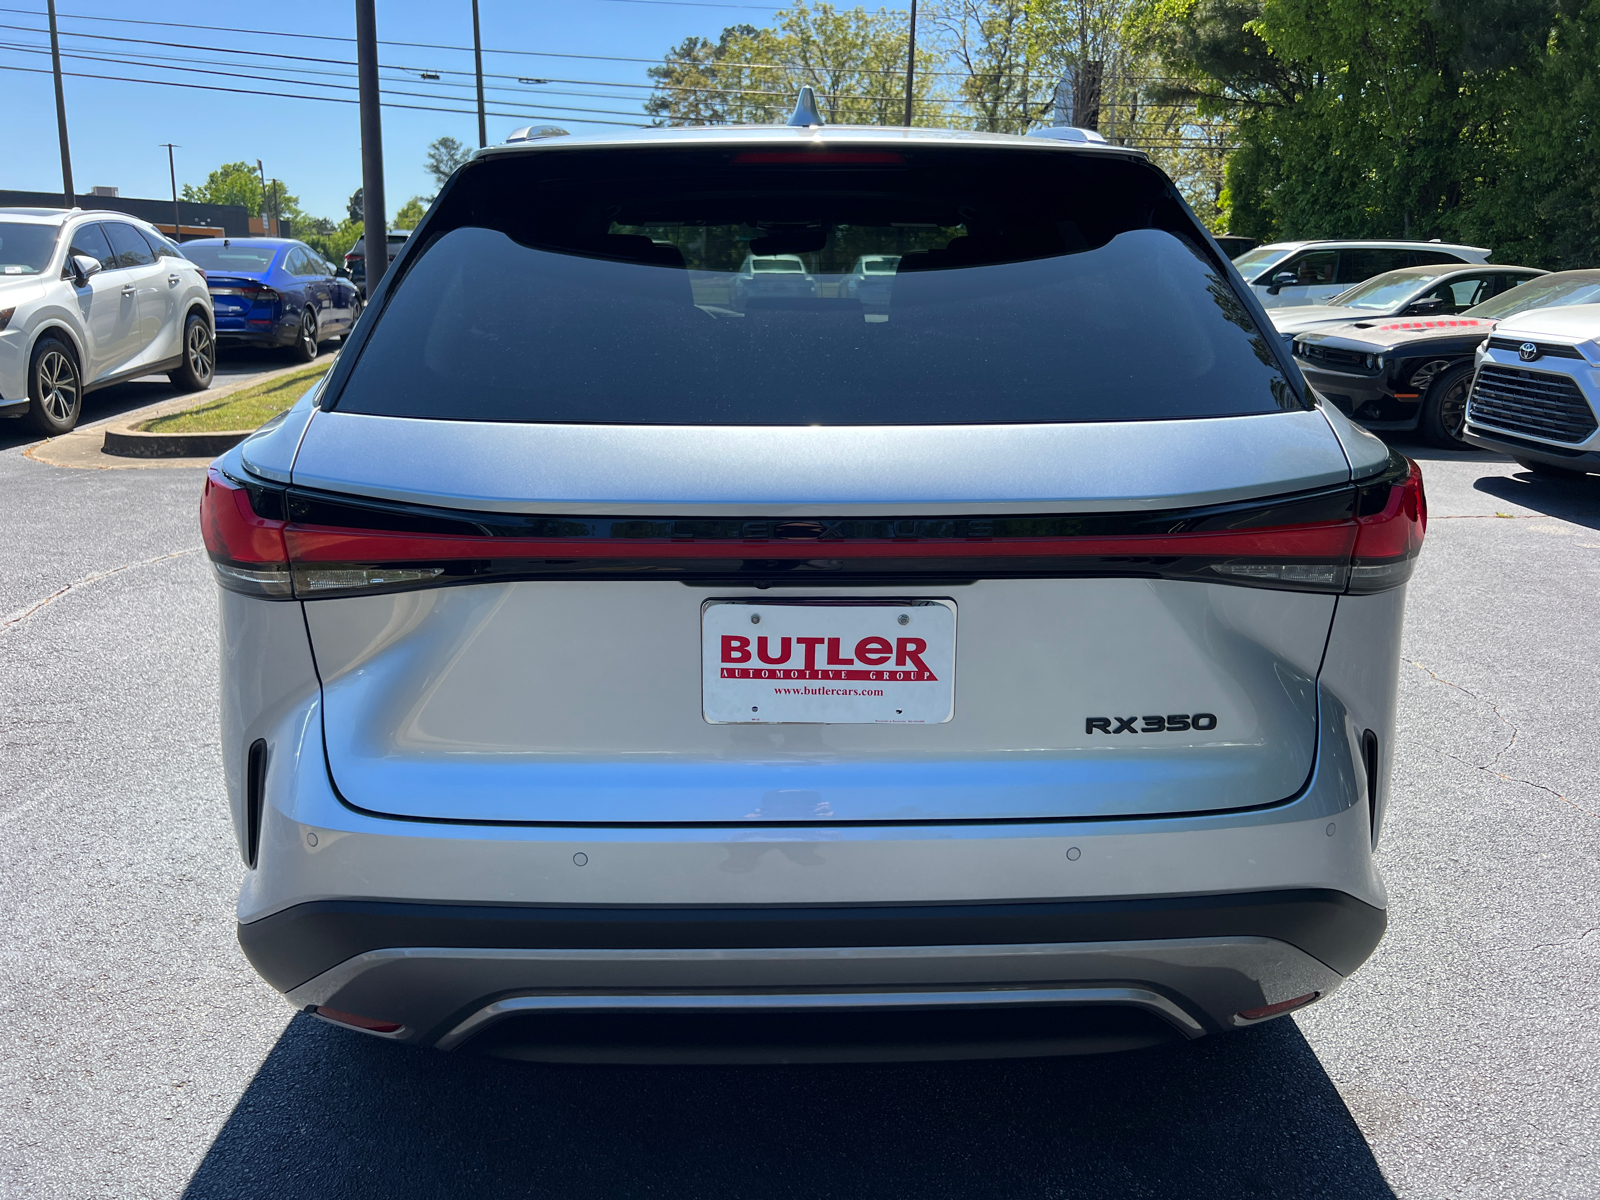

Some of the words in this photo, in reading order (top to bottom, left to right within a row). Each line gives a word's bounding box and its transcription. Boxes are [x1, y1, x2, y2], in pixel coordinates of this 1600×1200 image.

[670, 521, 993, 538] LEXUS
[722, 669, 848, 680] AUTOMOTIVE
[869, 671, 930, 681] GROUP
[774, 686, 884, 697] www.butlercars.com
[1085, 713, 1217, 735] RX350
